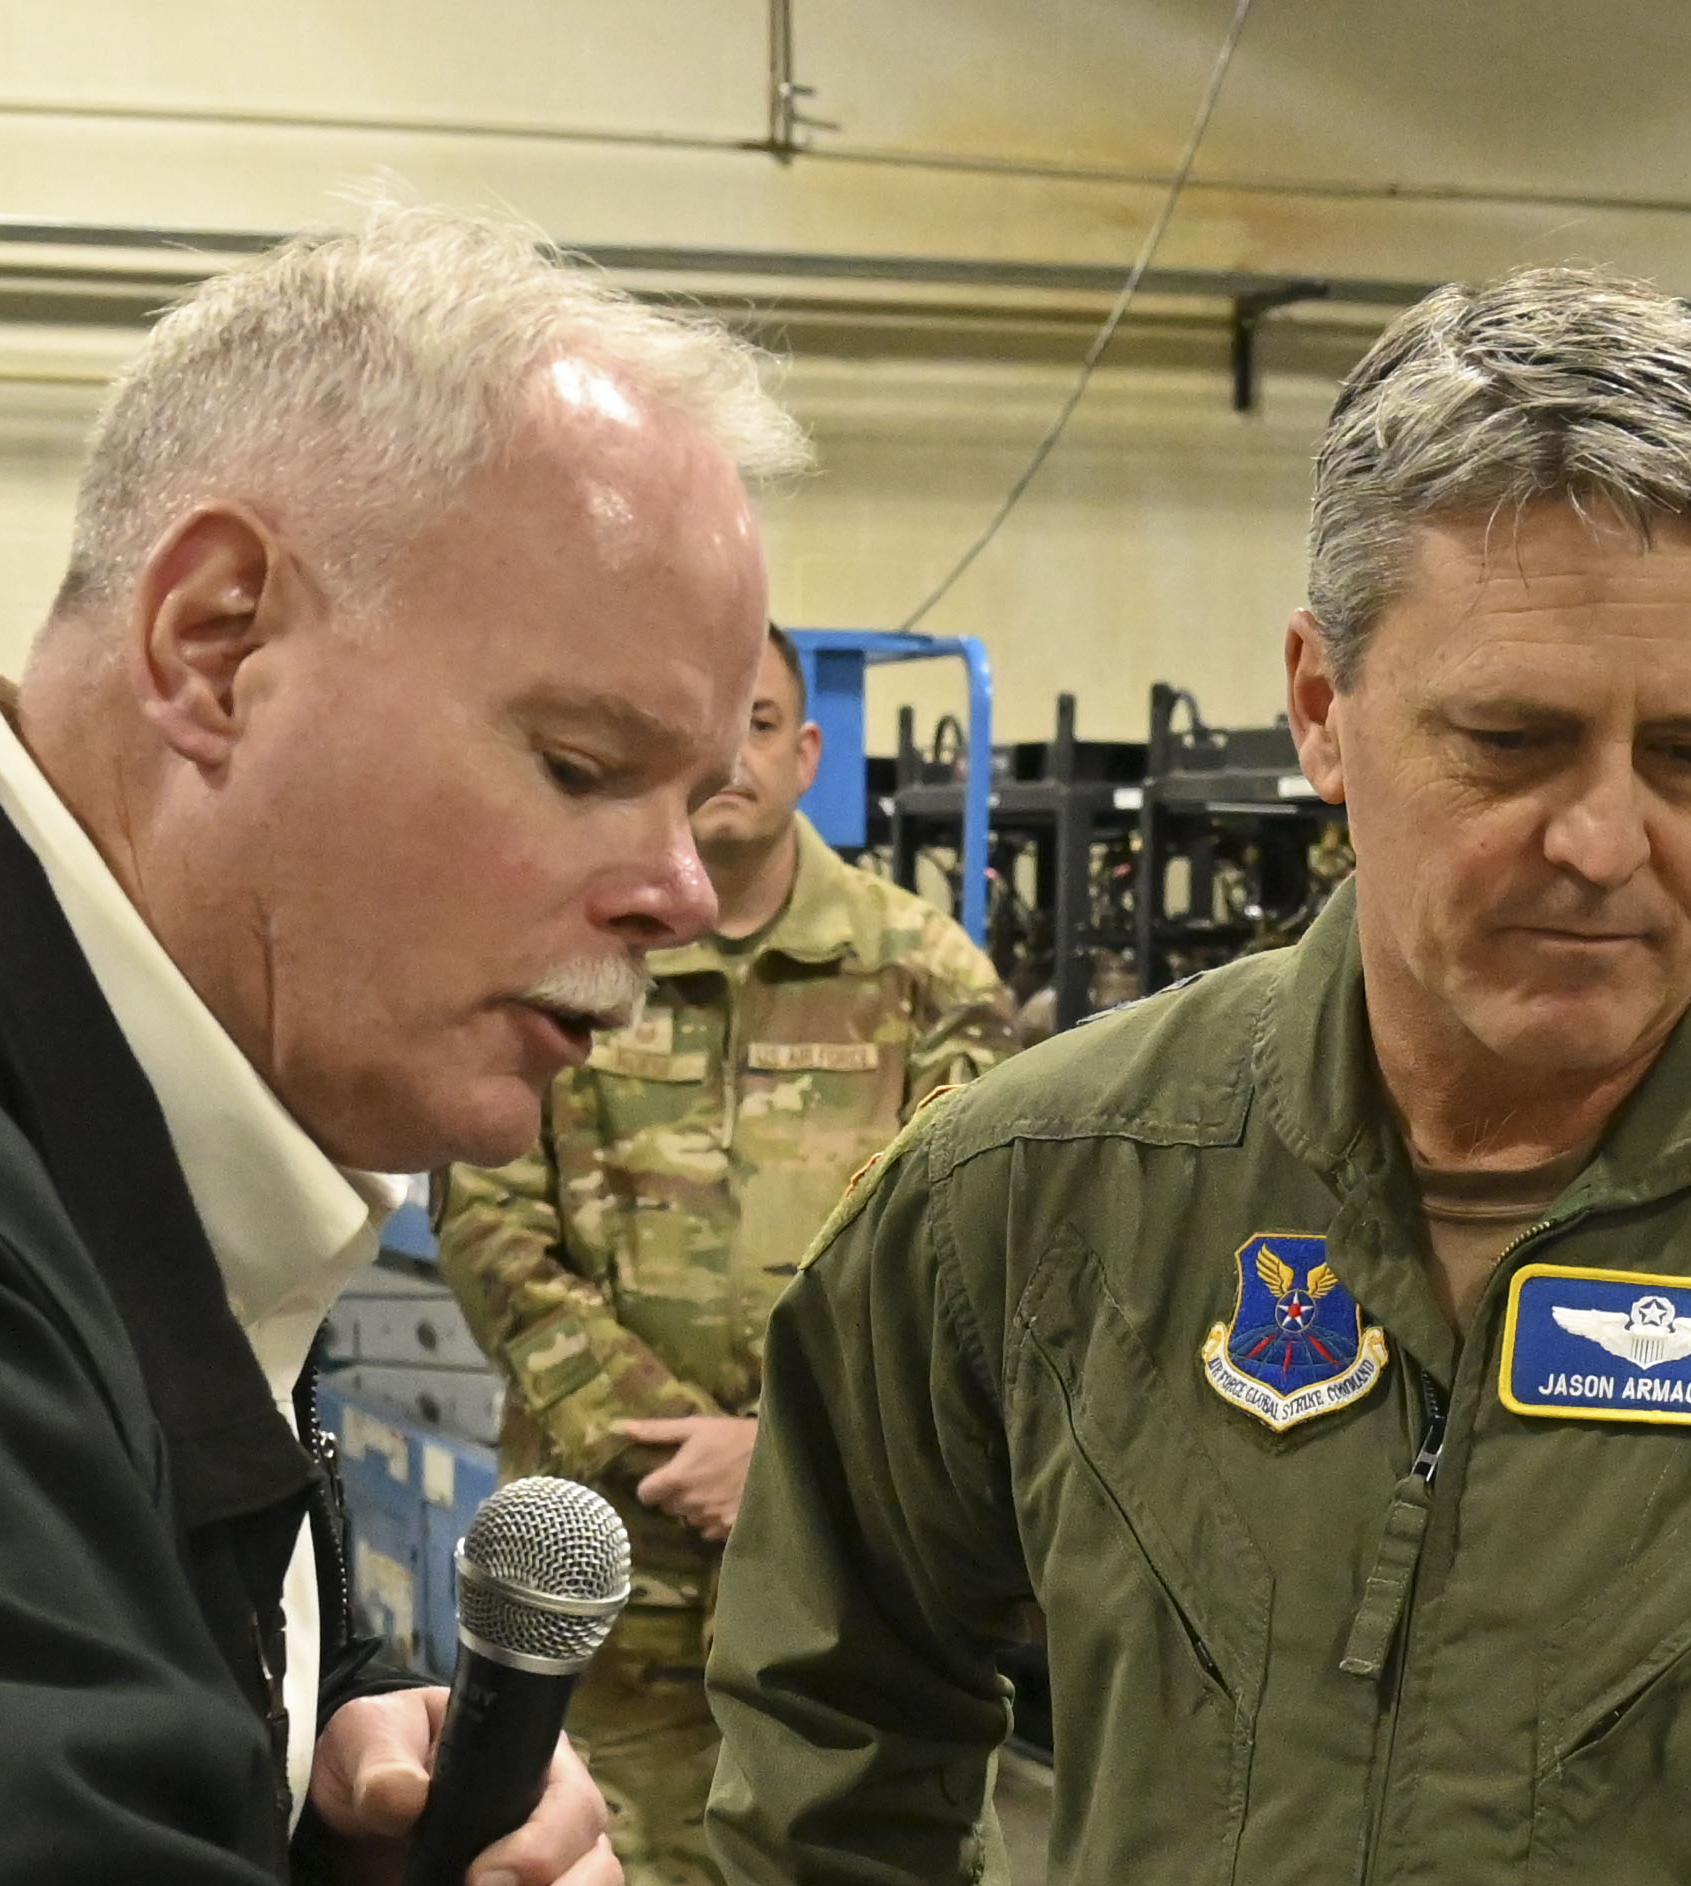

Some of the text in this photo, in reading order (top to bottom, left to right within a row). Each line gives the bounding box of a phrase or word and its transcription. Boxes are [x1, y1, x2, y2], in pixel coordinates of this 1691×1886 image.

[1218, 1367, 1247, 1399] FORCE
[1245, 1386, 1280, 1421] GLOBAL
[1282, 1389, 1323, 1421] STRIKE
[1538, 1373, 1615, 1399] JASON
